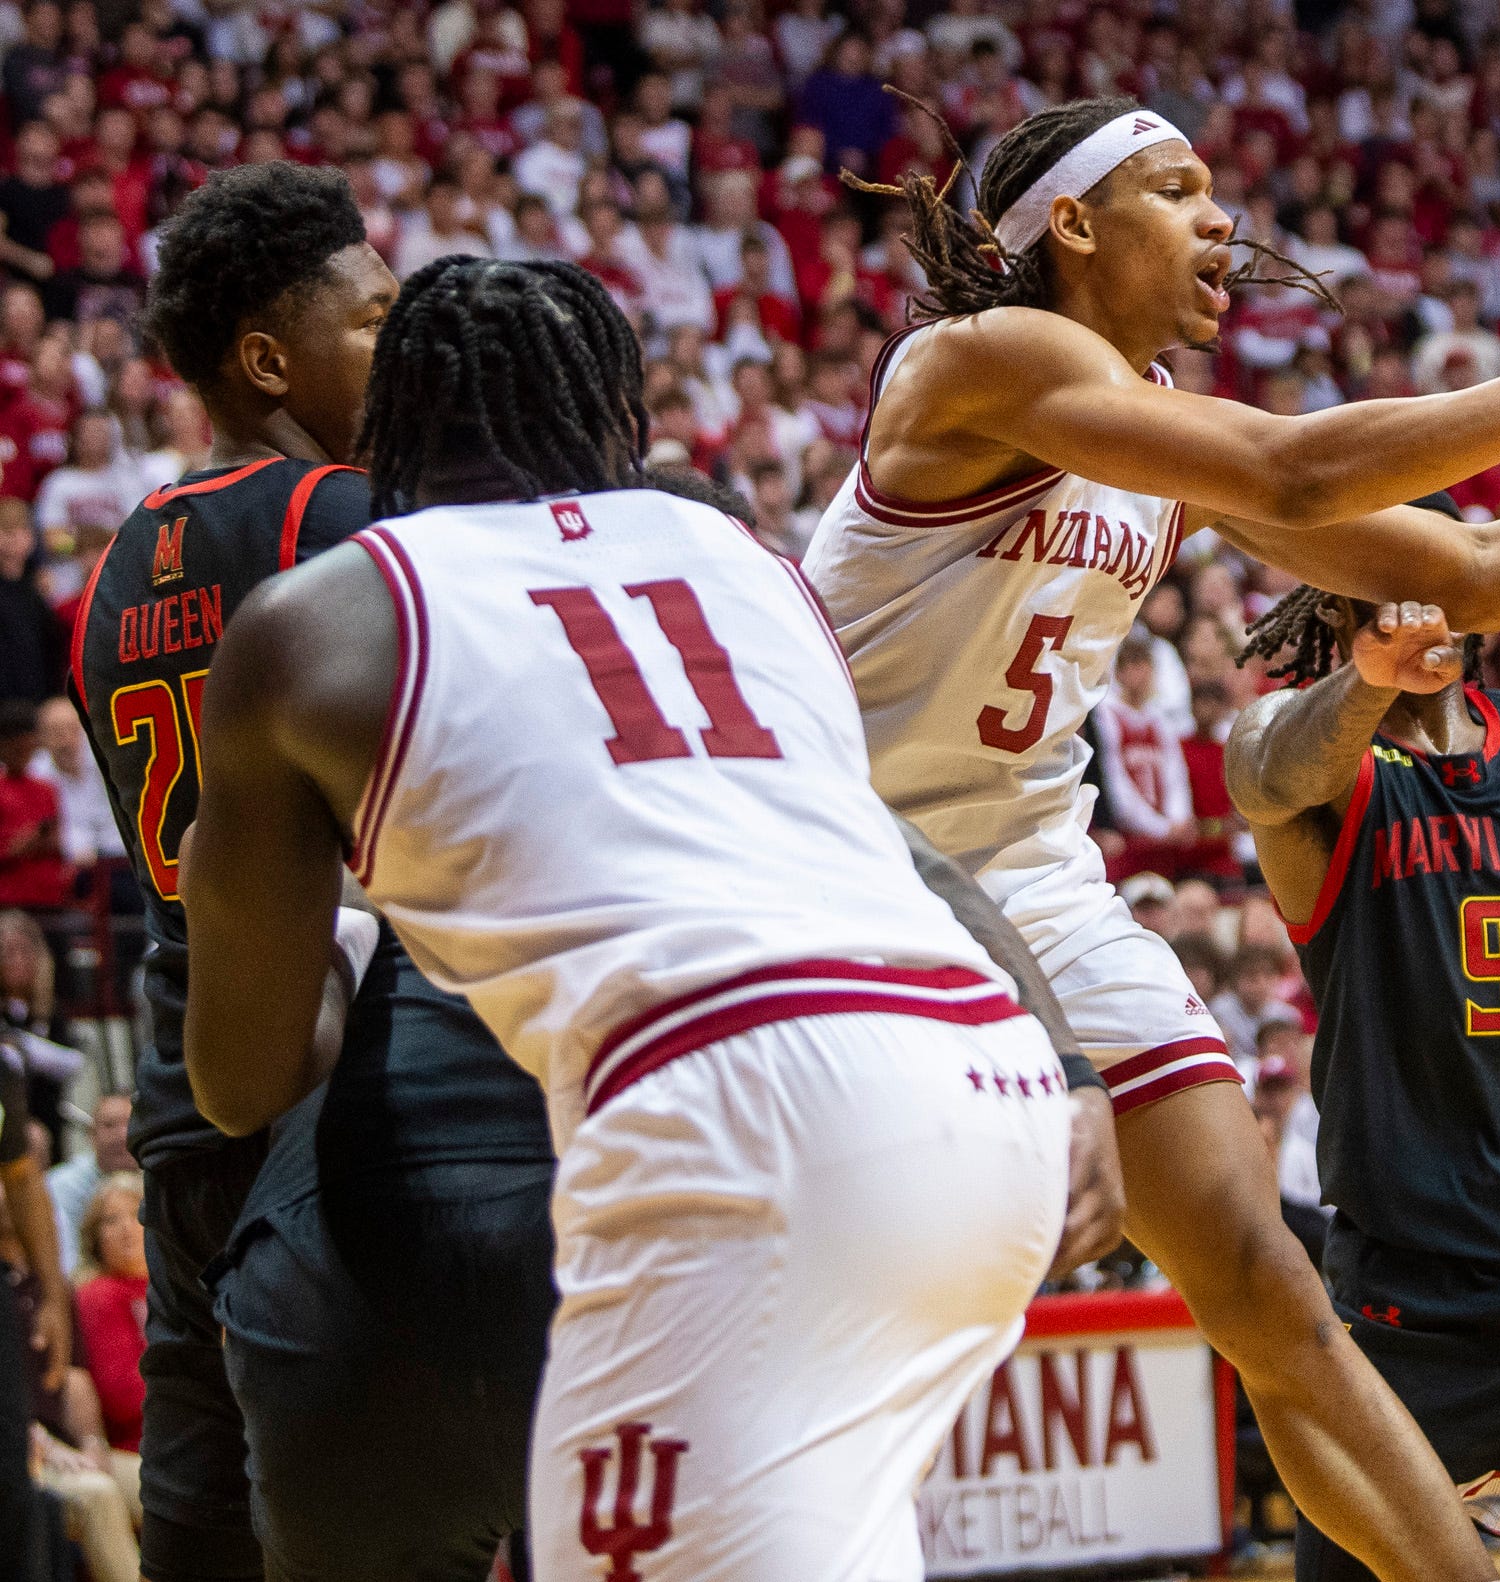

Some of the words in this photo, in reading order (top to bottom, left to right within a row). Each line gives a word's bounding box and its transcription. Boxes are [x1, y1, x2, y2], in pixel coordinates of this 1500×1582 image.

[152, 516, 188, 578] M
[118, 583, 224, 664] QUEEN
[527, 577, 785, 767] 11
[976, 613, 1074, 754] 5
[110, 668, 212, 901] 2
[946, 1344, 1158, 1480] IANA
[917, 1484, 1124, 1561] KETBALL
